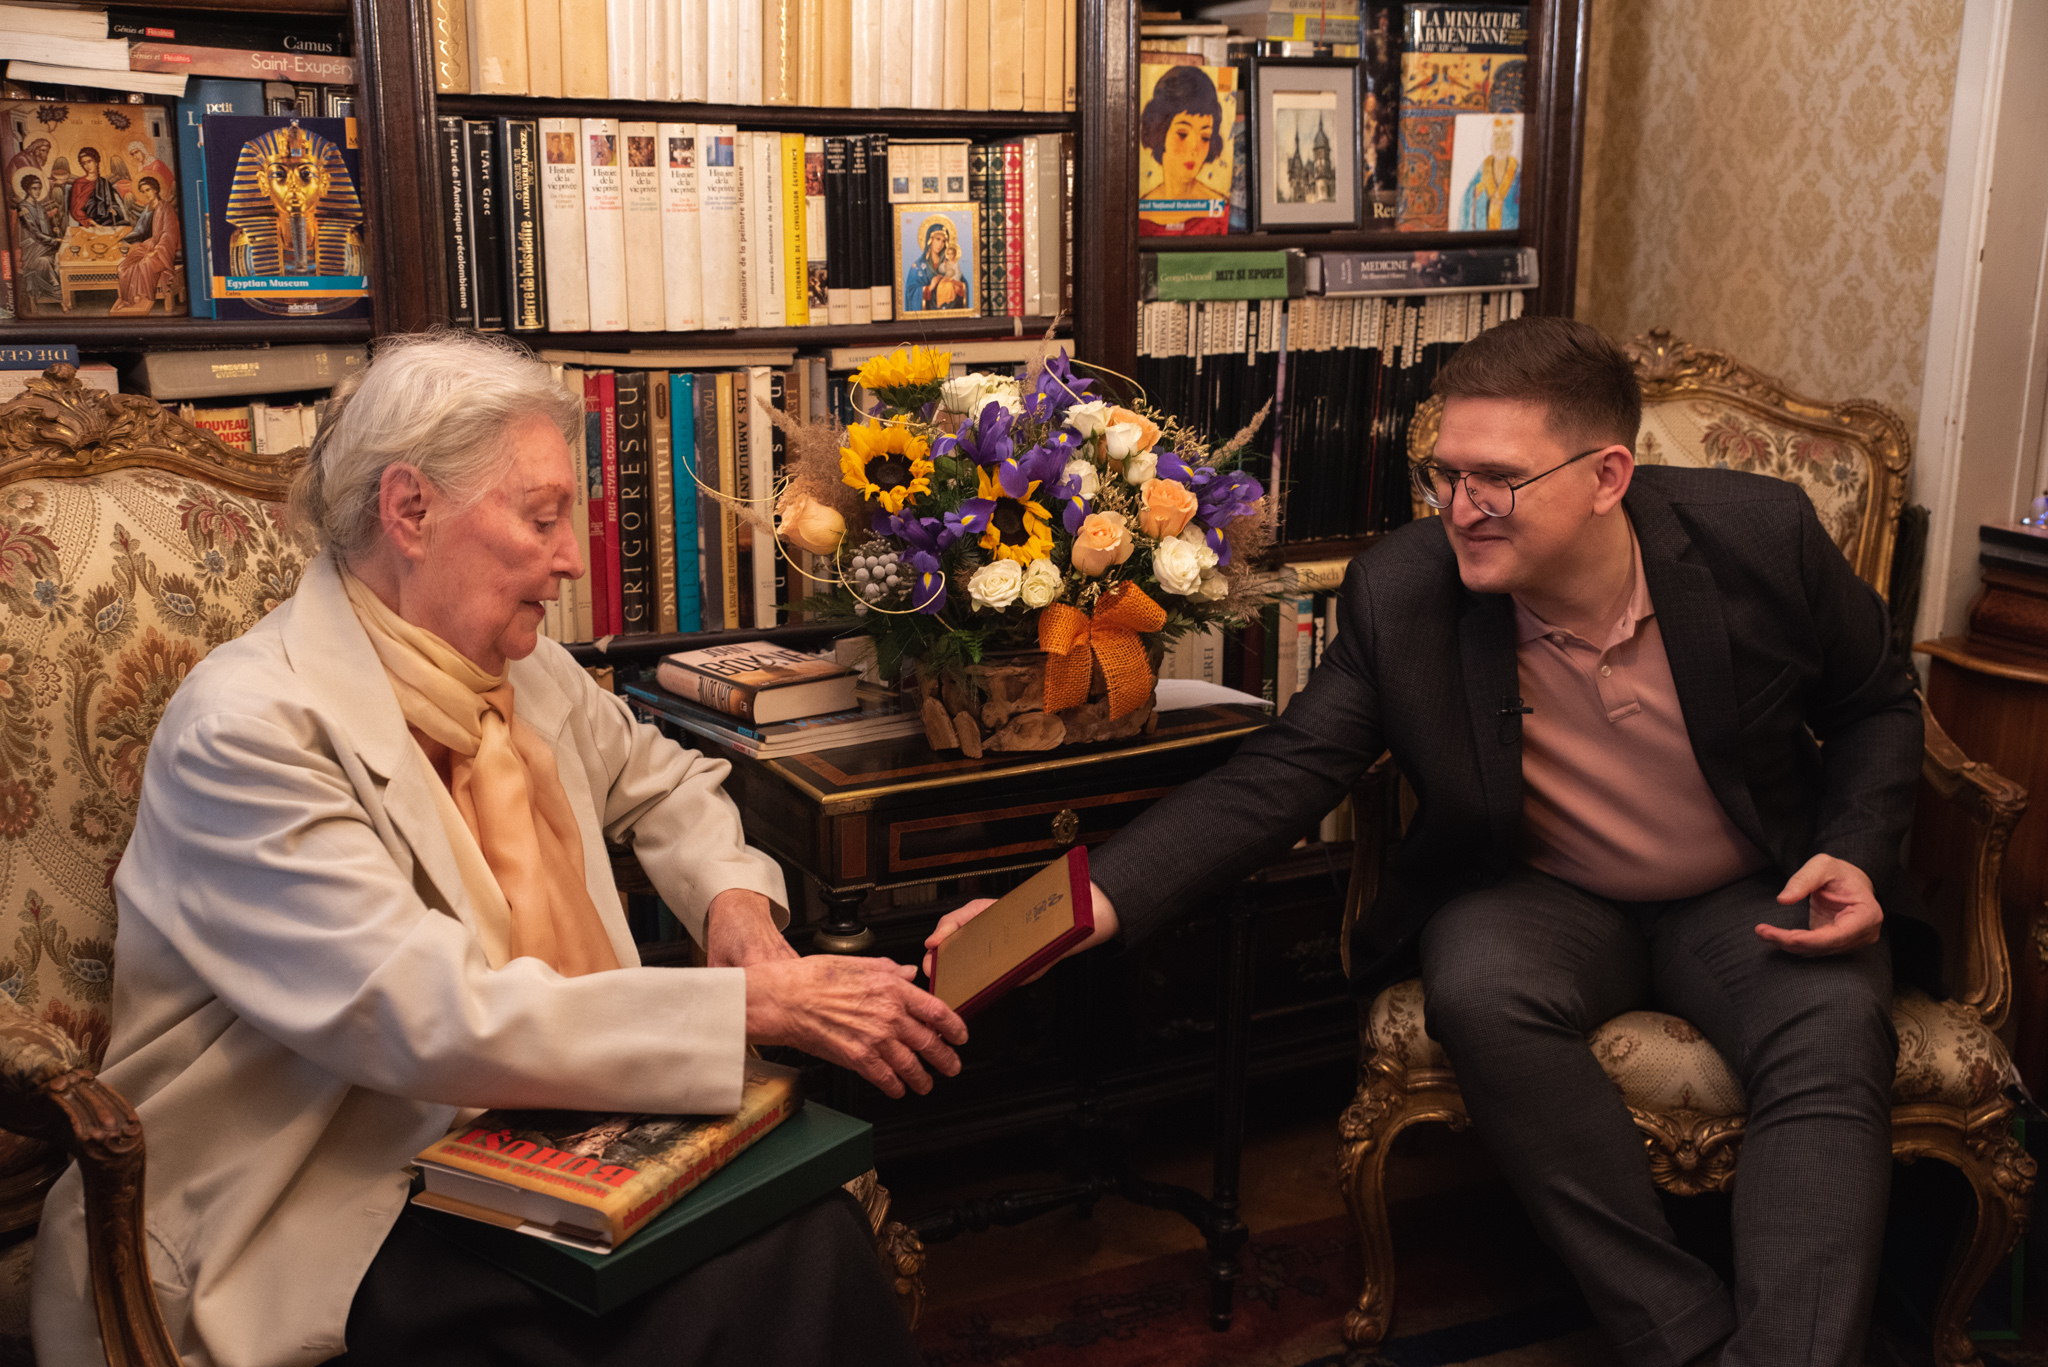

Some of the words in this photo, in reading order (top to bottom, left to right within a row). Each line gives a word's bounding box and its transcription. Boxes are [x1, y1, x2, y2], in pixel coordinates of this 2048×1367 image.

[1422, 10, 1440, 26] LA
[1444, 10, 1521, 28] MINIATURE
[114, 24, 137, 34] Génies
[283, 35, 333, 52] Camus
[206, 102, 234, 114] petit
[450, 140, 458, 163] L'art
[452, 166, 460, 177] de
[481, 150, 490, 180] L'Art
[514, 164, 522, 190] ISTORIE
[560, 183, 577, 191] privée
[640, 186, 656, 194] privée
[453, 180, 463, 232] l'Amérique
[482, 188, 492, 216] Grec
[1208, 199, 1224, 217] 15
[739, 207, 747, 242] peinture
[739, 257, 746, 267] de
[1361, 260, 1408, 272] MEDICINE
[454, 235, 468, 309] précolombienne
[1160, 274, 1185, 282] Georges
[1216, 270, 1234, 281] MIT
[1248, 268, 1284, 279] EPOPEE
[227, 279, 266, 289] Egyptian
[269, 279, 309, 287] Museum
[520, 277, 535, 291] de
[521, 292, 538, 326] pierre
[36, 349, 70, 361] DIE
[737, 388, 747, 414] LES
[703, 389, 716, 438] ITALIAN
[195, 419, 248, 431] NOUVEAU
[215, 430, 252, 442] OUSSE
[657, 437, 672, 514] ITALIAN
[619, 387, 643, 621] GRIGORESCU
[680, 496, 696, 618] VILNIAUS
[660, 524, 675, 616] PAINTING
[1306, 568, 1338, 582] Dutch
[730, 610, 736, 618] LA
[700, 646, 752, 658] JOHN
[698, 649, 818, 676] BOYNE
[454, 1128, 640, 1188] BUHUȘI
